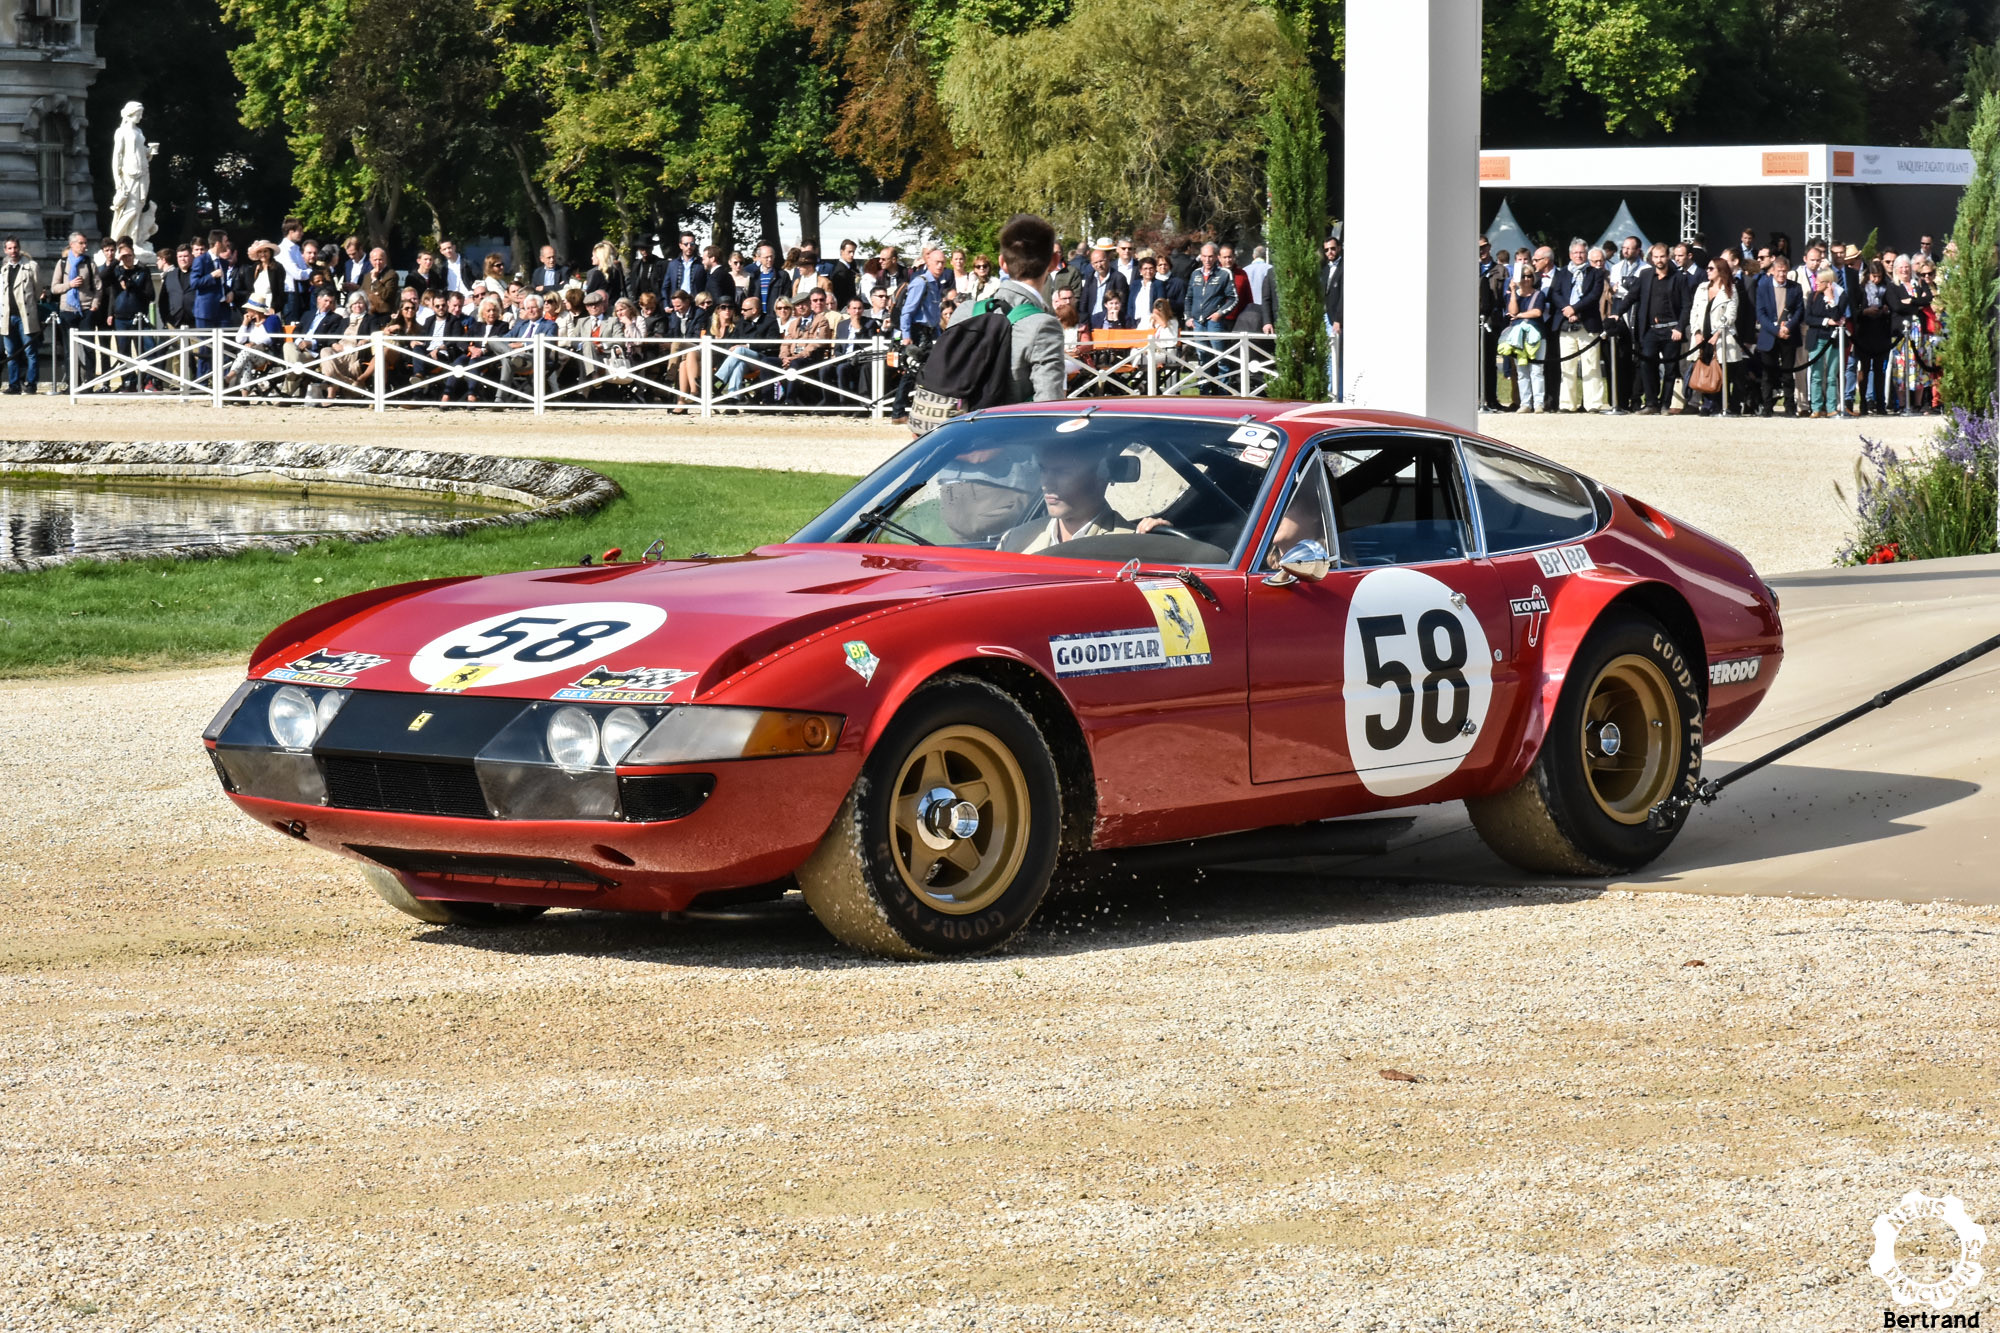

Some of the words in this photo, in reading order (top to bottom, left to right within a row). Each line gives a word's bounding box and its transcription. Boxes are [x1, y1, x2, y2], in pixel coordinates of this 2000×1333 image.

[1539, 551, 1561, 575] BP
[1565, 547, 1587, 570] BP
[1513, 600, 1547, 612] KONI
[443, 616, 632, 663] 58
[849, 643, 867, 659] BP
[1056, 638, 1161, 666] GOODYEAR
[291, 672, 349, 685] MARCHAL
[1356, 608, 1470, 751] 58
[588, 690, 665, 701] MARCHAL
